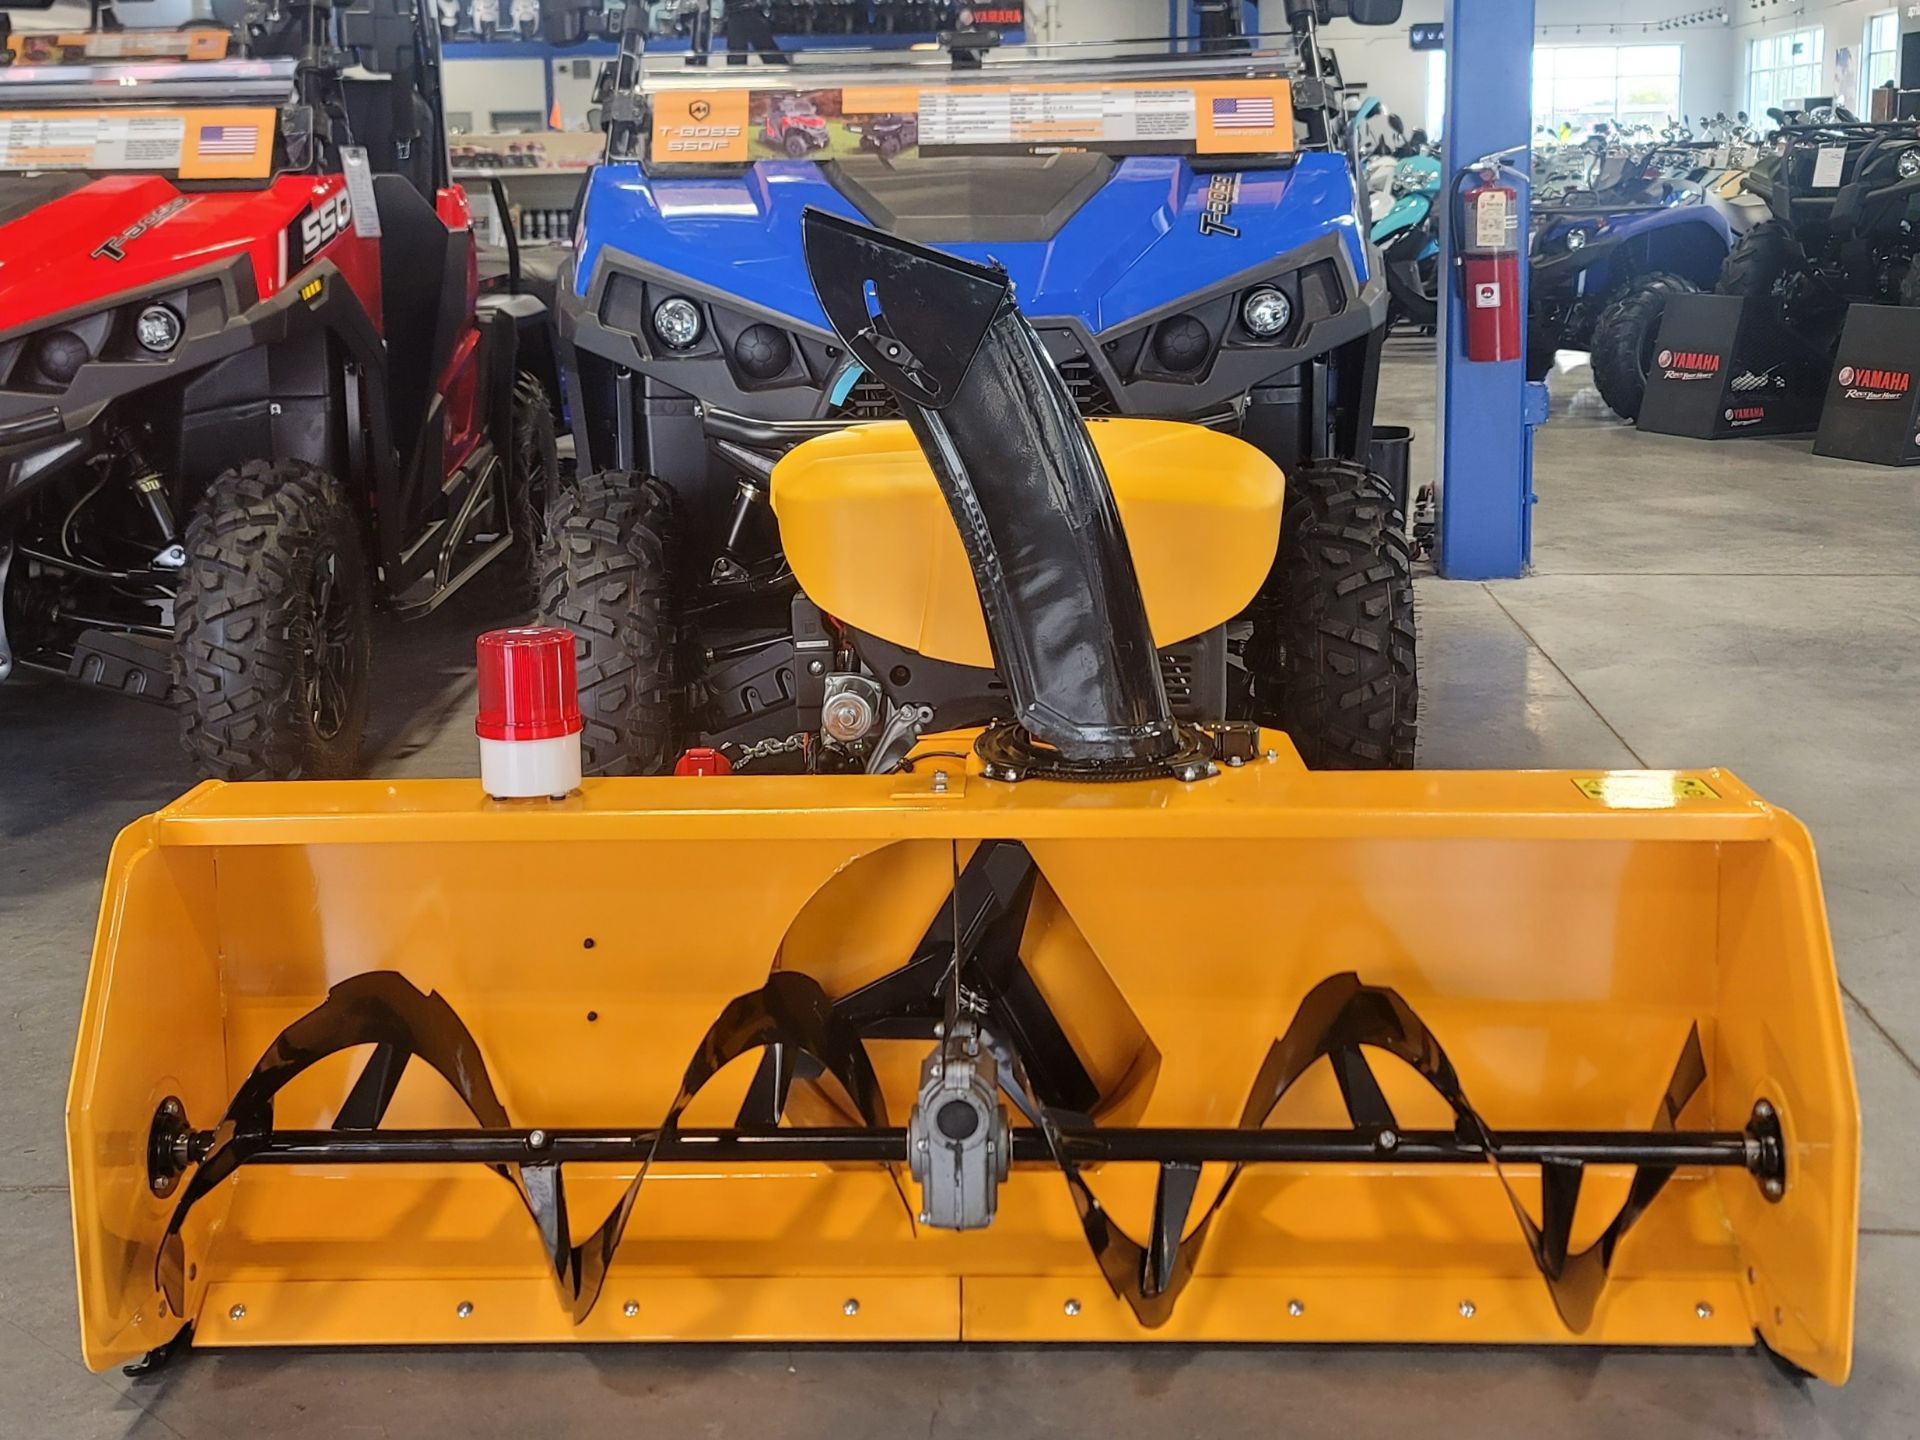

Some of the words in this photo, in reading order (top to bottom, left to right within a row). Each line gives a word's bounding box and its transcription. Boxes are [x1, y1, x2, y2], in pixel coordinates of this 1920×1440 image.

[659, 127, 741, 137] T-BOSS
[301, 186, 352, 257] 550
[1672, 352, 1720, 371] YAMAHA
[1855, 369, 1910, 392] YAMAHA
